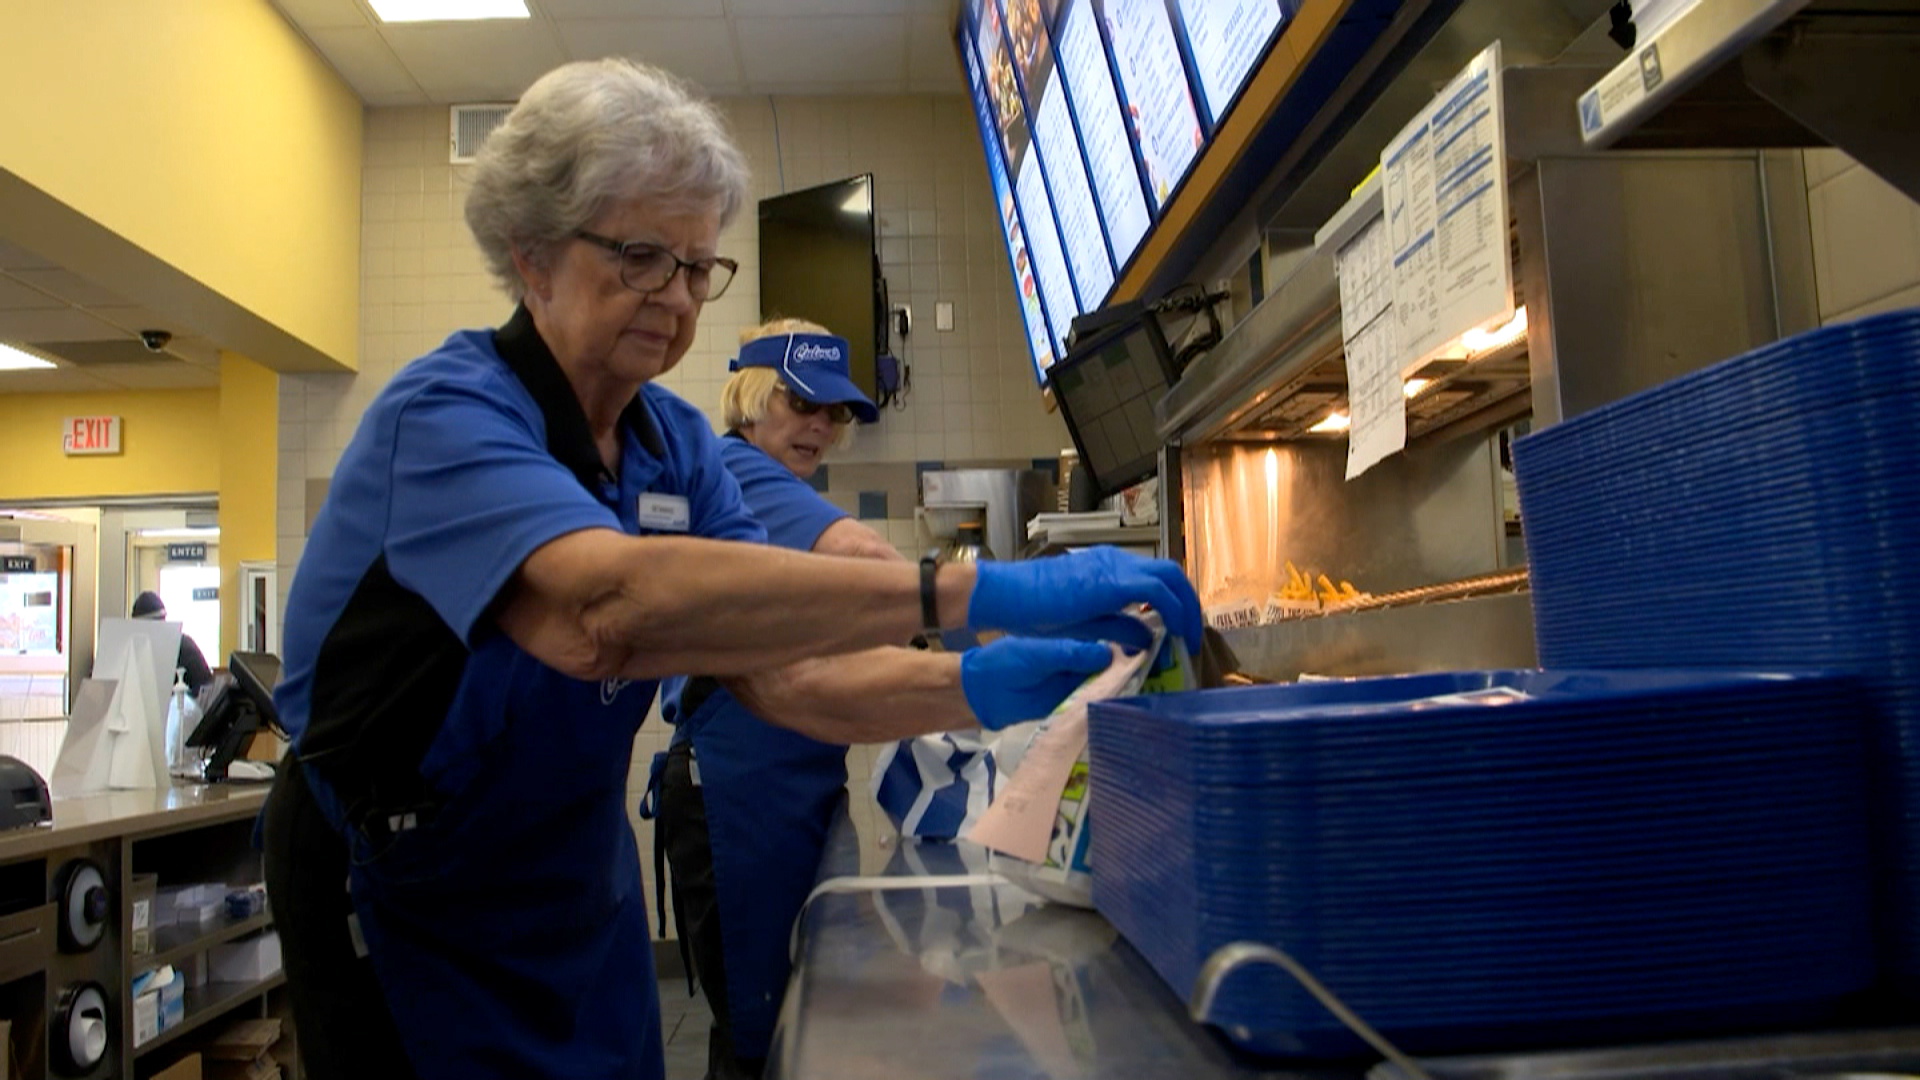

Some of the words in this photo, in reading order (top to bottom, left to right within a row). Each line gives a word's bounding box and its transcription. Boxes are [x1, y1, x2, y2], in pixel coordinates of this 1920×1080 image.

[72, 417, 112, 449] EXIT
[171, 546, 204, 557] ENTER
[7, 559, 30, 570] EXIT
